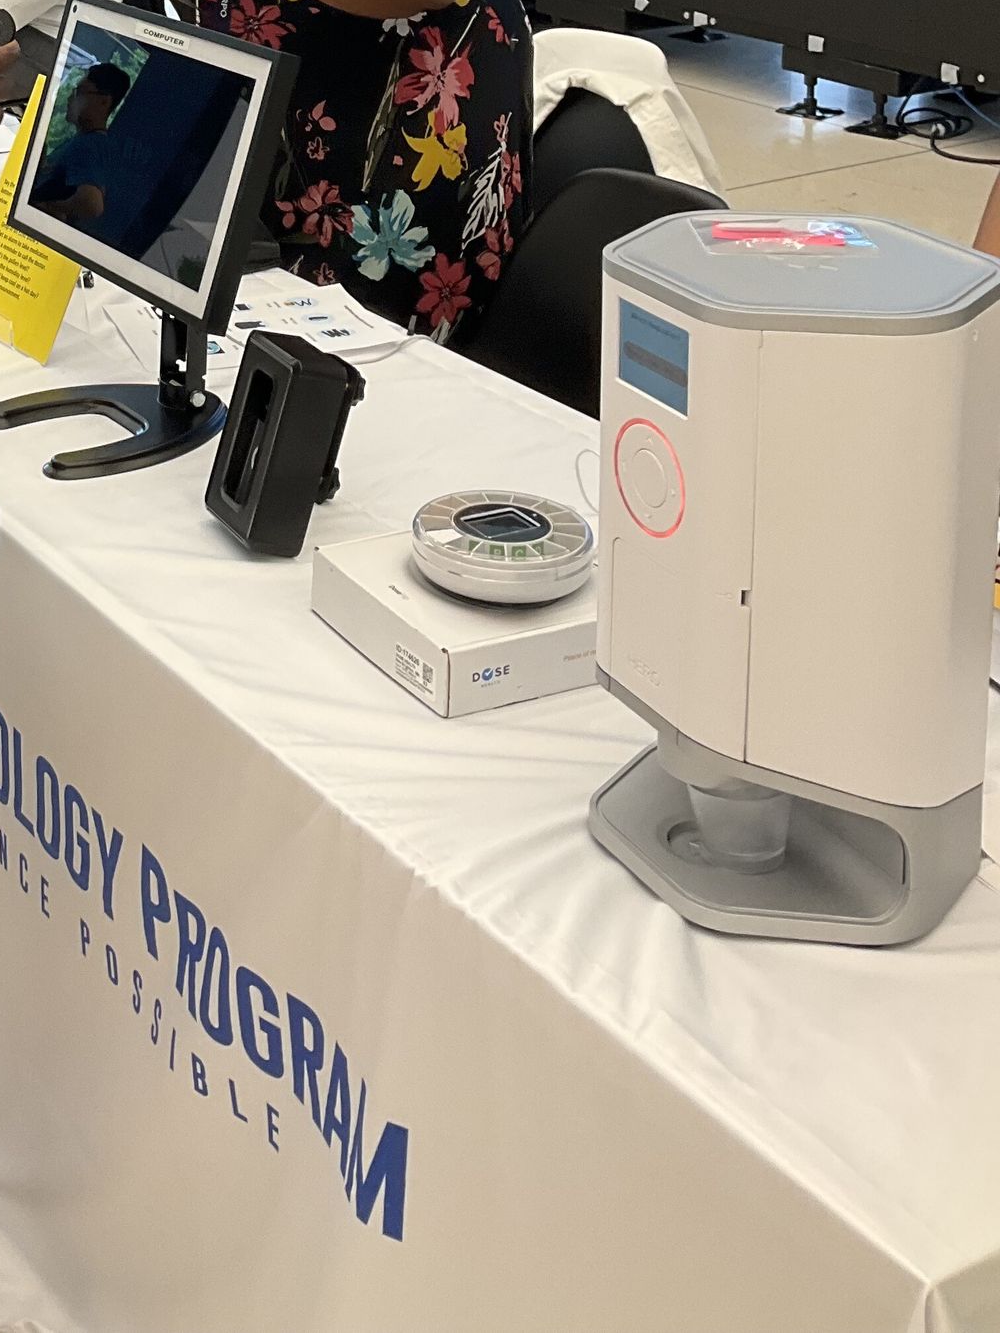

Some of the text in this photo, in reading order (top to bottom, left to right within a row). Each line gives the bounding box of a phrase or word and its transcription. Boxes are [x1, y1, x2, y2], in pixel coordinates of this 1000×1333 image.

[143, 28, 185, 47] COMPUTER
[472, 664, 510, 682] DOSE
[80, 917, 281, 1153] POSSIBLE
[141, 843, 410, 1243] PROGRAM
